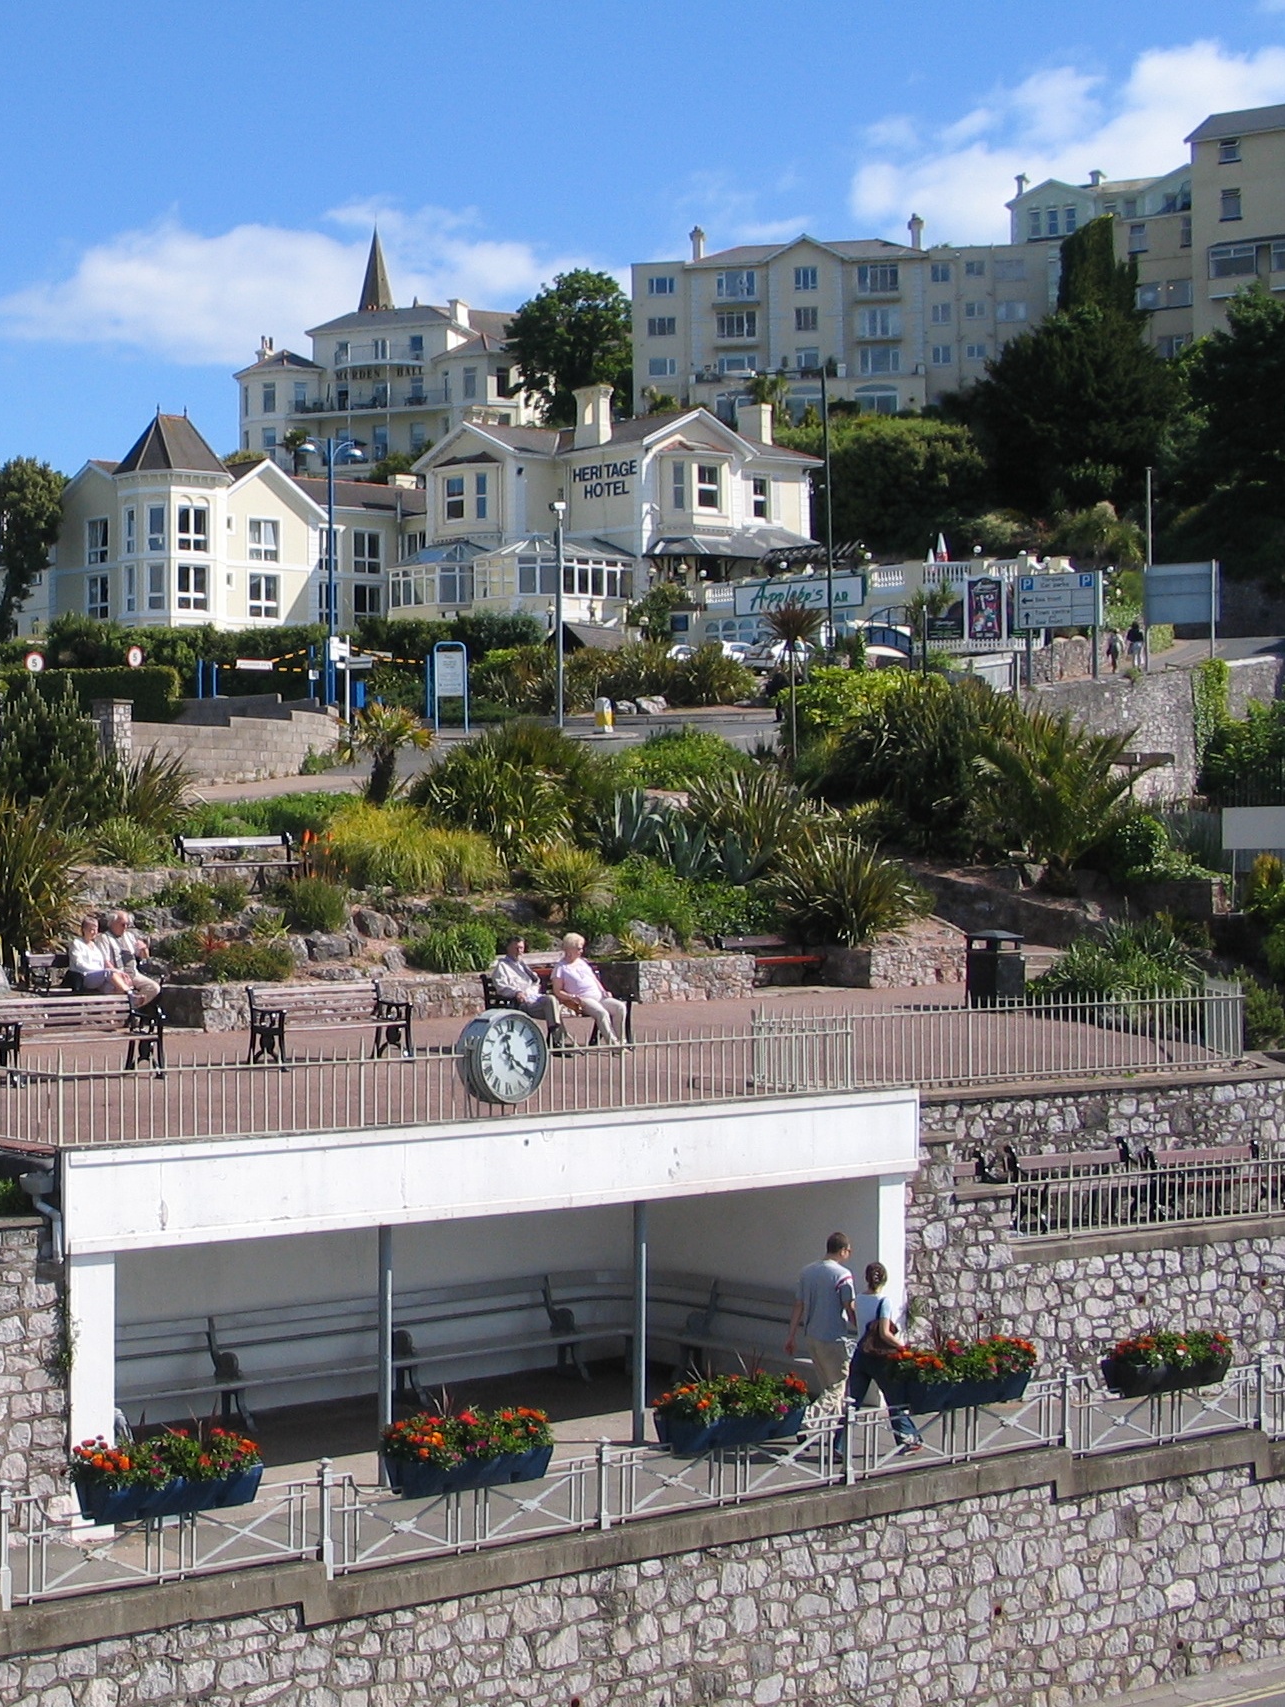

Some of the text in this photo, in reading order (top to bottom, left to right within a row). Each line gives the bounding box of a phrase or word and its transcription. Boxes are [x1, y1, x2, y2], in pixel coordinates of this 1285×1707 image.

[573, 459, 638, 483] HERITAGE
[584, 480, 631, 500] HOTEL
[831, 590, 850, 604] AR
[31, 658, 38, 667] 5
[132, 653, 138, 662] 5
